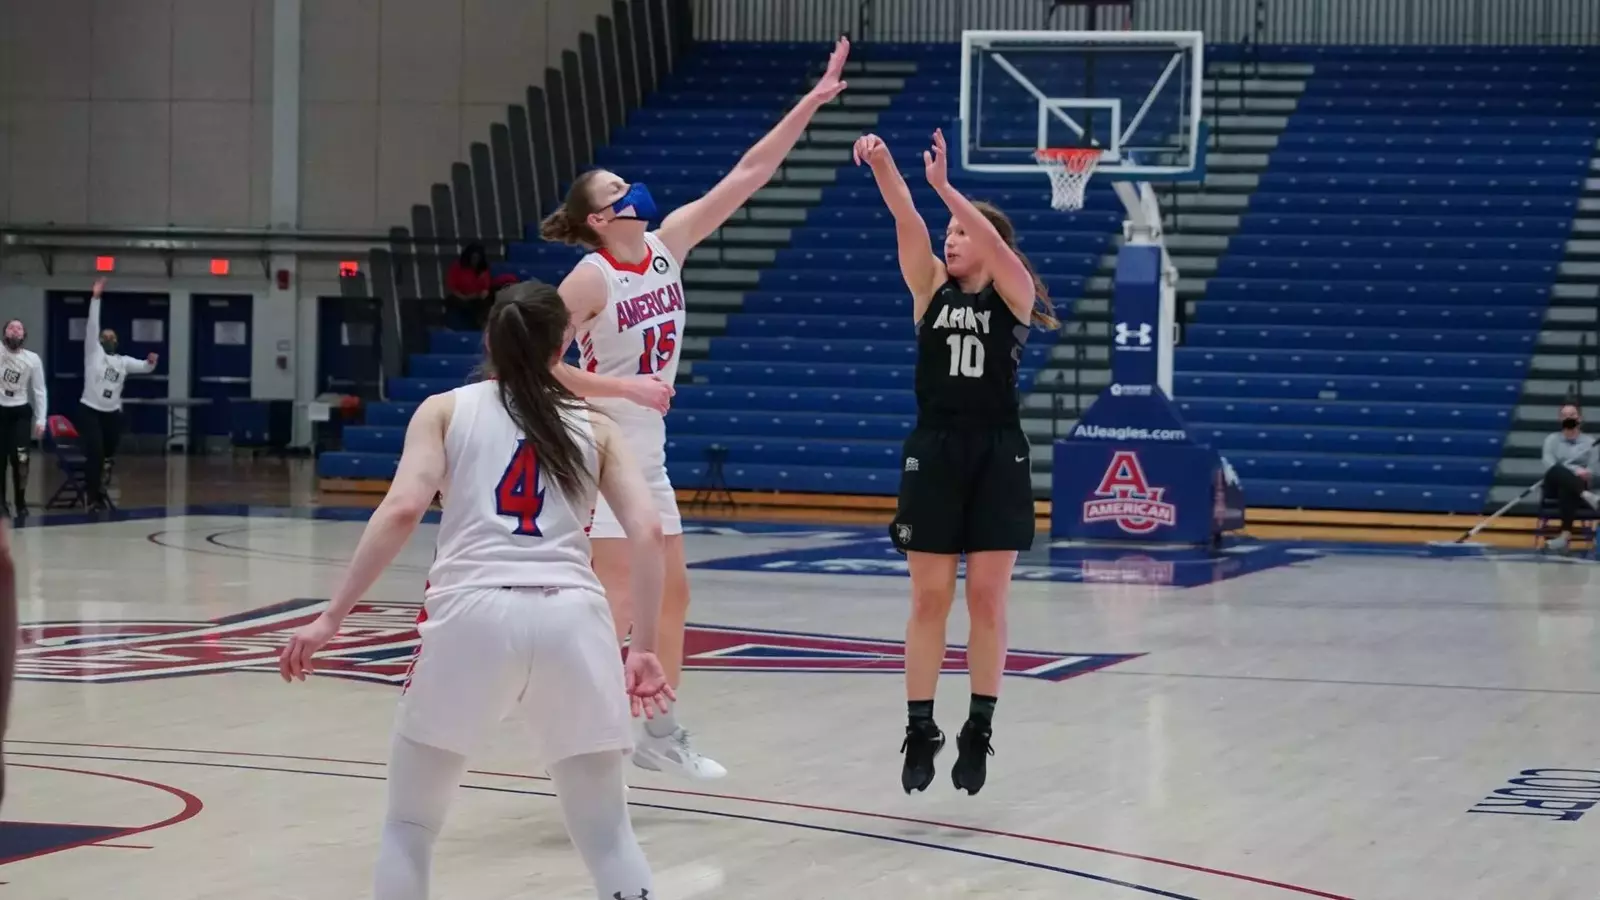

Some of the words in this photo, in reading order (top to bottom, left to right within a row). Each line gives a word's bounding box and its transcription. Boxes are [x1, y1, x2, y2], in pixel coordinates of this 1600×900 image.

[932, 304, 991, 334] ARMY
[636, 320, 677, 375] 15
[946, 333, 985, 378] 10
[1075, 425, 1187, 440] AUeagles.com
[494, 438, 546, 537] 4
[1088, 502, 1171, 519] AMERICAN
